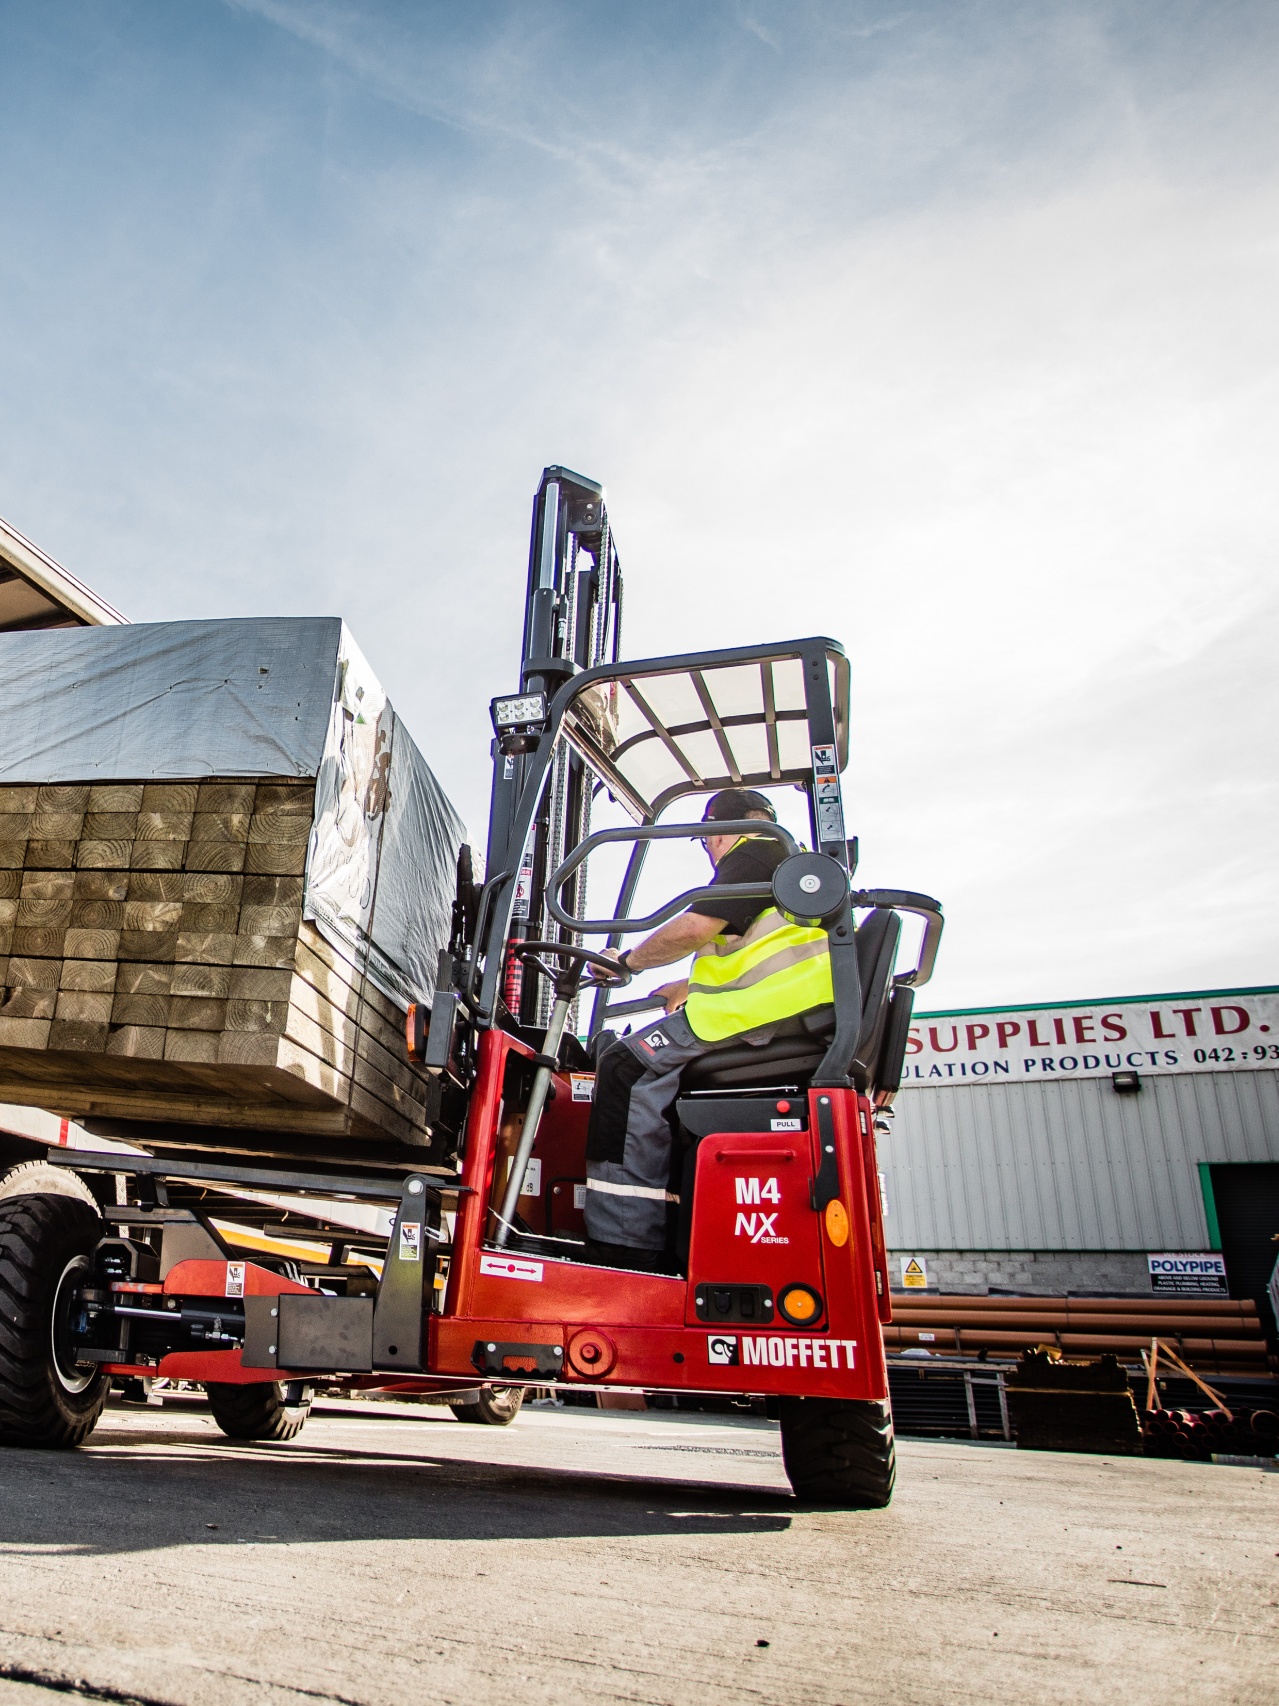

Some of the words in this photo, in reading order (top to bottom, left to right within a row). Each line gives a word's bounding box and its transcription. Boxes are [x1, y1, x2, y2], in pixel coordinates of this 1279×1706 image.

[505, 938, 525, 1014] MOFFET
[905, 1013, 1127, 1055] SUPPLIES
[1149, 1005, 1270, 1039] LTD.
[1024, 1050, 1179, 1073] PRODUCTS
[735, 1177, 781, 1204] M4
[734, 1212, 779, 1243] NX
[761, 1236, 789, 1244] SERIES
[1151, 1260, 1223, 1273] POLYPIPE
[742, 1336, 857, 1369] MOFFETT
